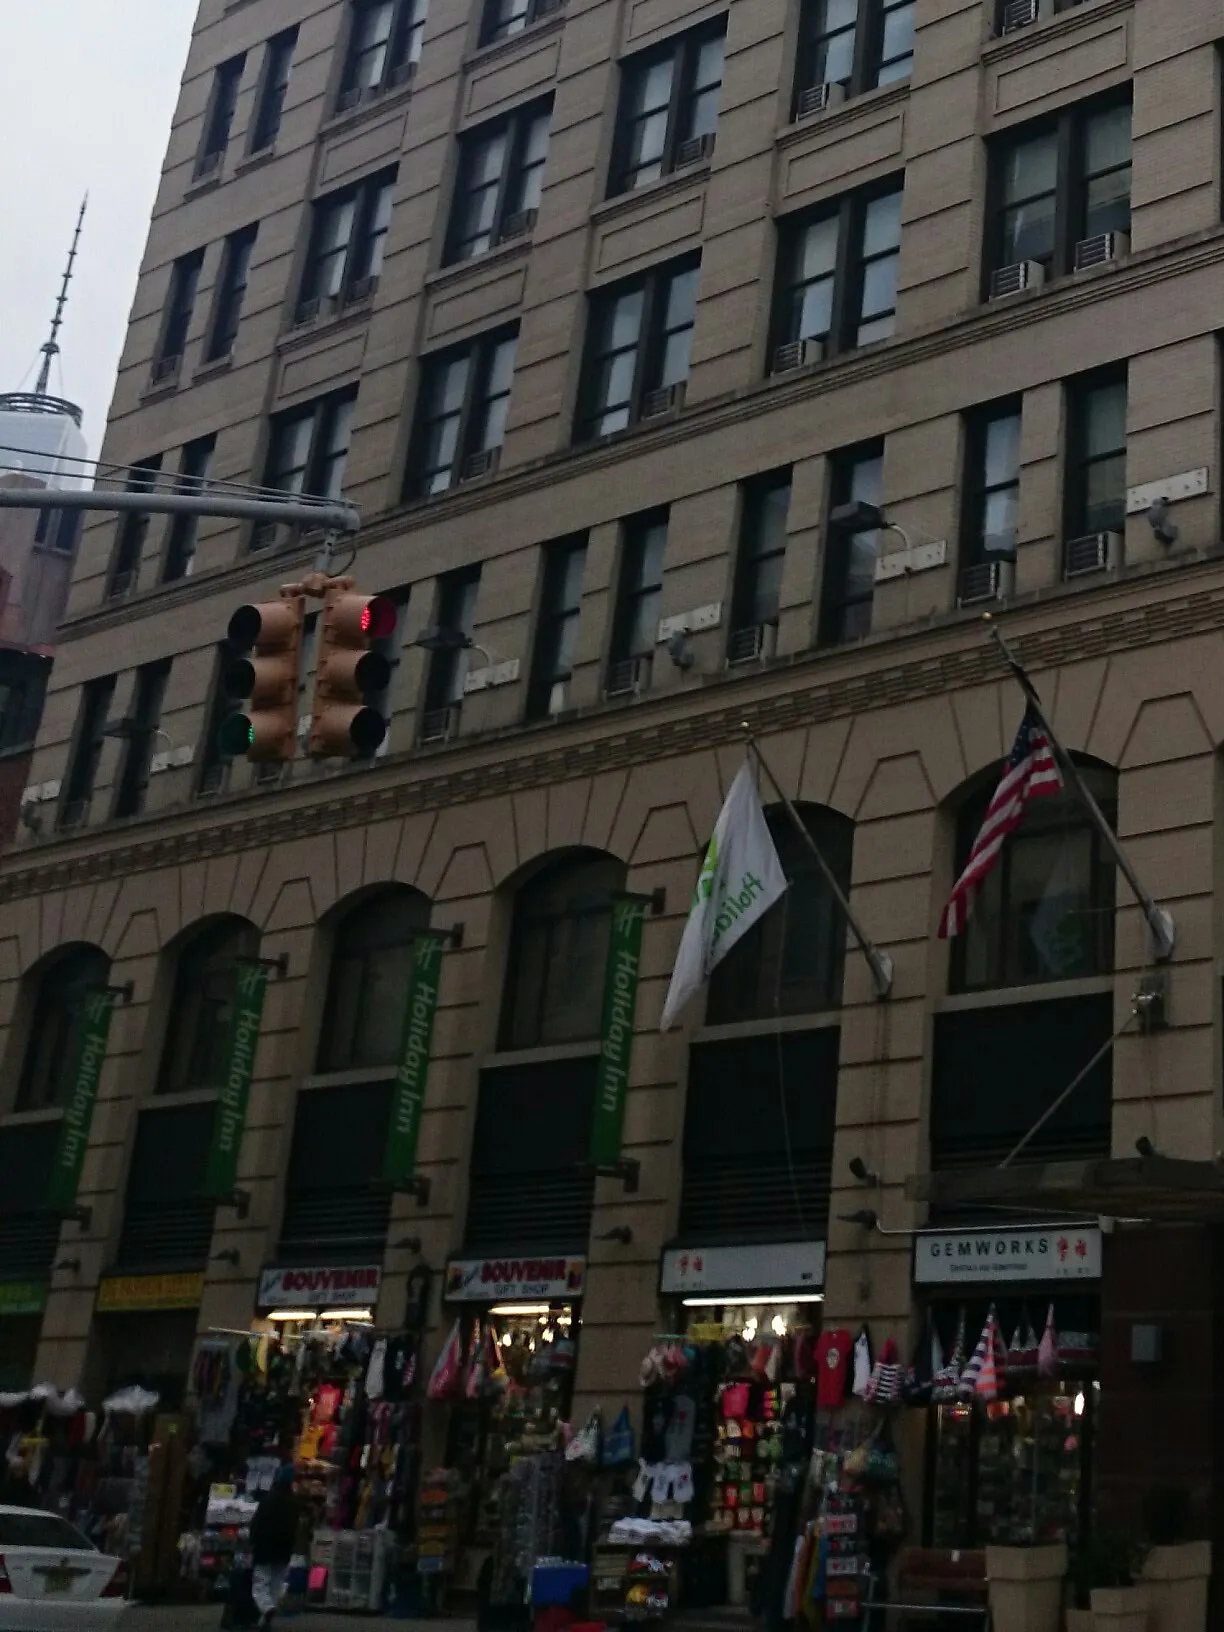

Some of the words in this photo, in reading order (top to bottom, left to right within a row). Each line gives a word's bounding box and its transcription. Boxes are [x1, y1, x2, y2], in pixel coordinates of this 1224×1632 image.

[602, 950, 639, 1063] Holiday
[222, 1009, 261, 1107] Holiday
[400, 982, 436, 1088] Holiday
[64, 1033, 105, 1126] Holiday
[601, 1063, 626, 1112] Inn
[218, 1109, 243, 1153] Inn
[396, 1088, 421, 1134] Inn
[61, 1128, 88, 1167] Inn
[930, 1238, 1049, 1257] GEMWORKS
[282, 1269, 377, 1291] SOUVENIR
[481, 1259, 566, 1283] SOUVENIR
